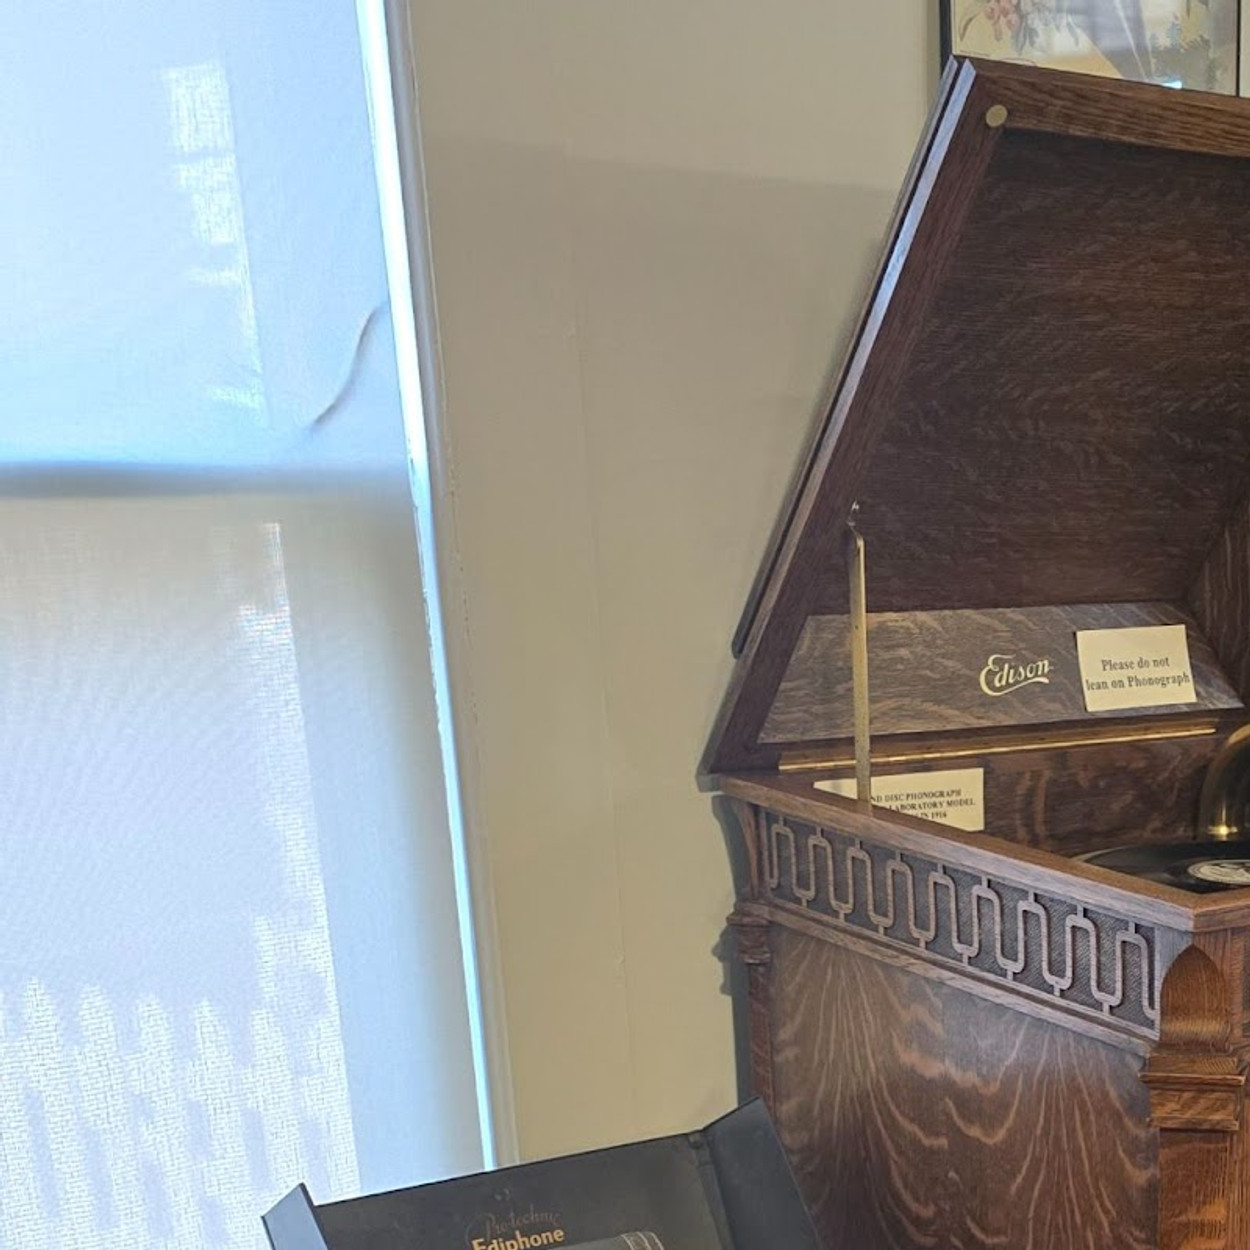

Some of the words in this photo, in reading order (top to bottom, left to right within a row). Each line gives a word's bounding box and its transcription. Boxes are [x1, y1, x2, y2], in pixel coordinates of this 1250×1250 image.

[1101, 658, 1135, 672] Please
[1137, 656, 1150, 669] do
[1153, 657, 1170, 667] not
[980, 654, 1054, 696] Edison
[1085, 679, 1109, 691] lean
[1111, 680, 1125, 689] on
[1127, 671, 1190, 688] Phonograph
[884, 793, 904, 802] DISC
[905, 789, 962, 800] PHONOGRAPH
[946, 799, 976, 808] MODEL
